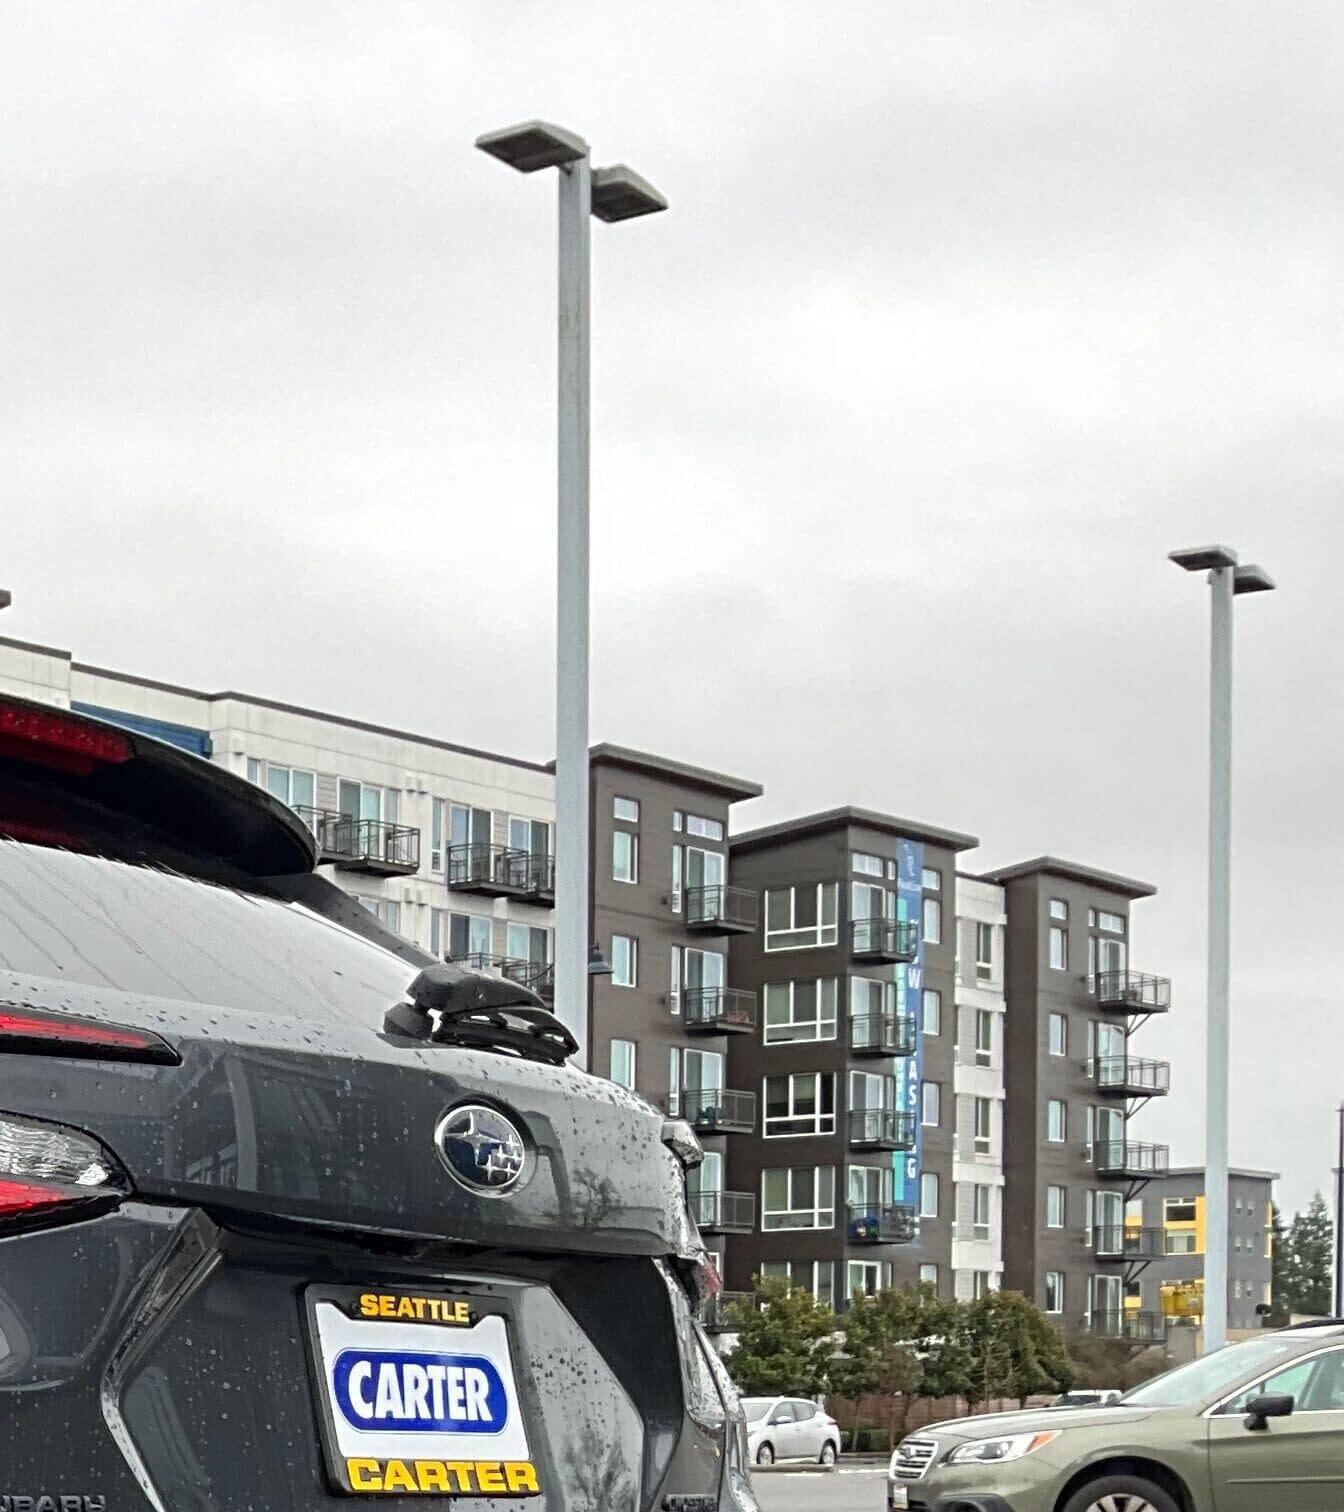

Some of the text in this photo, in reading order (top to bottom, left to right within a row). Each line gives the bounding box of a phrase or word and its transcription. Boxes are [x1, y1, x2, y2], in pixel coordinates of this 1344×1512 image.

[360, 1293, 470, 1323] SEATTLE
[348, 1360, 493, 1422] CARTER
[346, 1458, 540, 1492] CARTER
